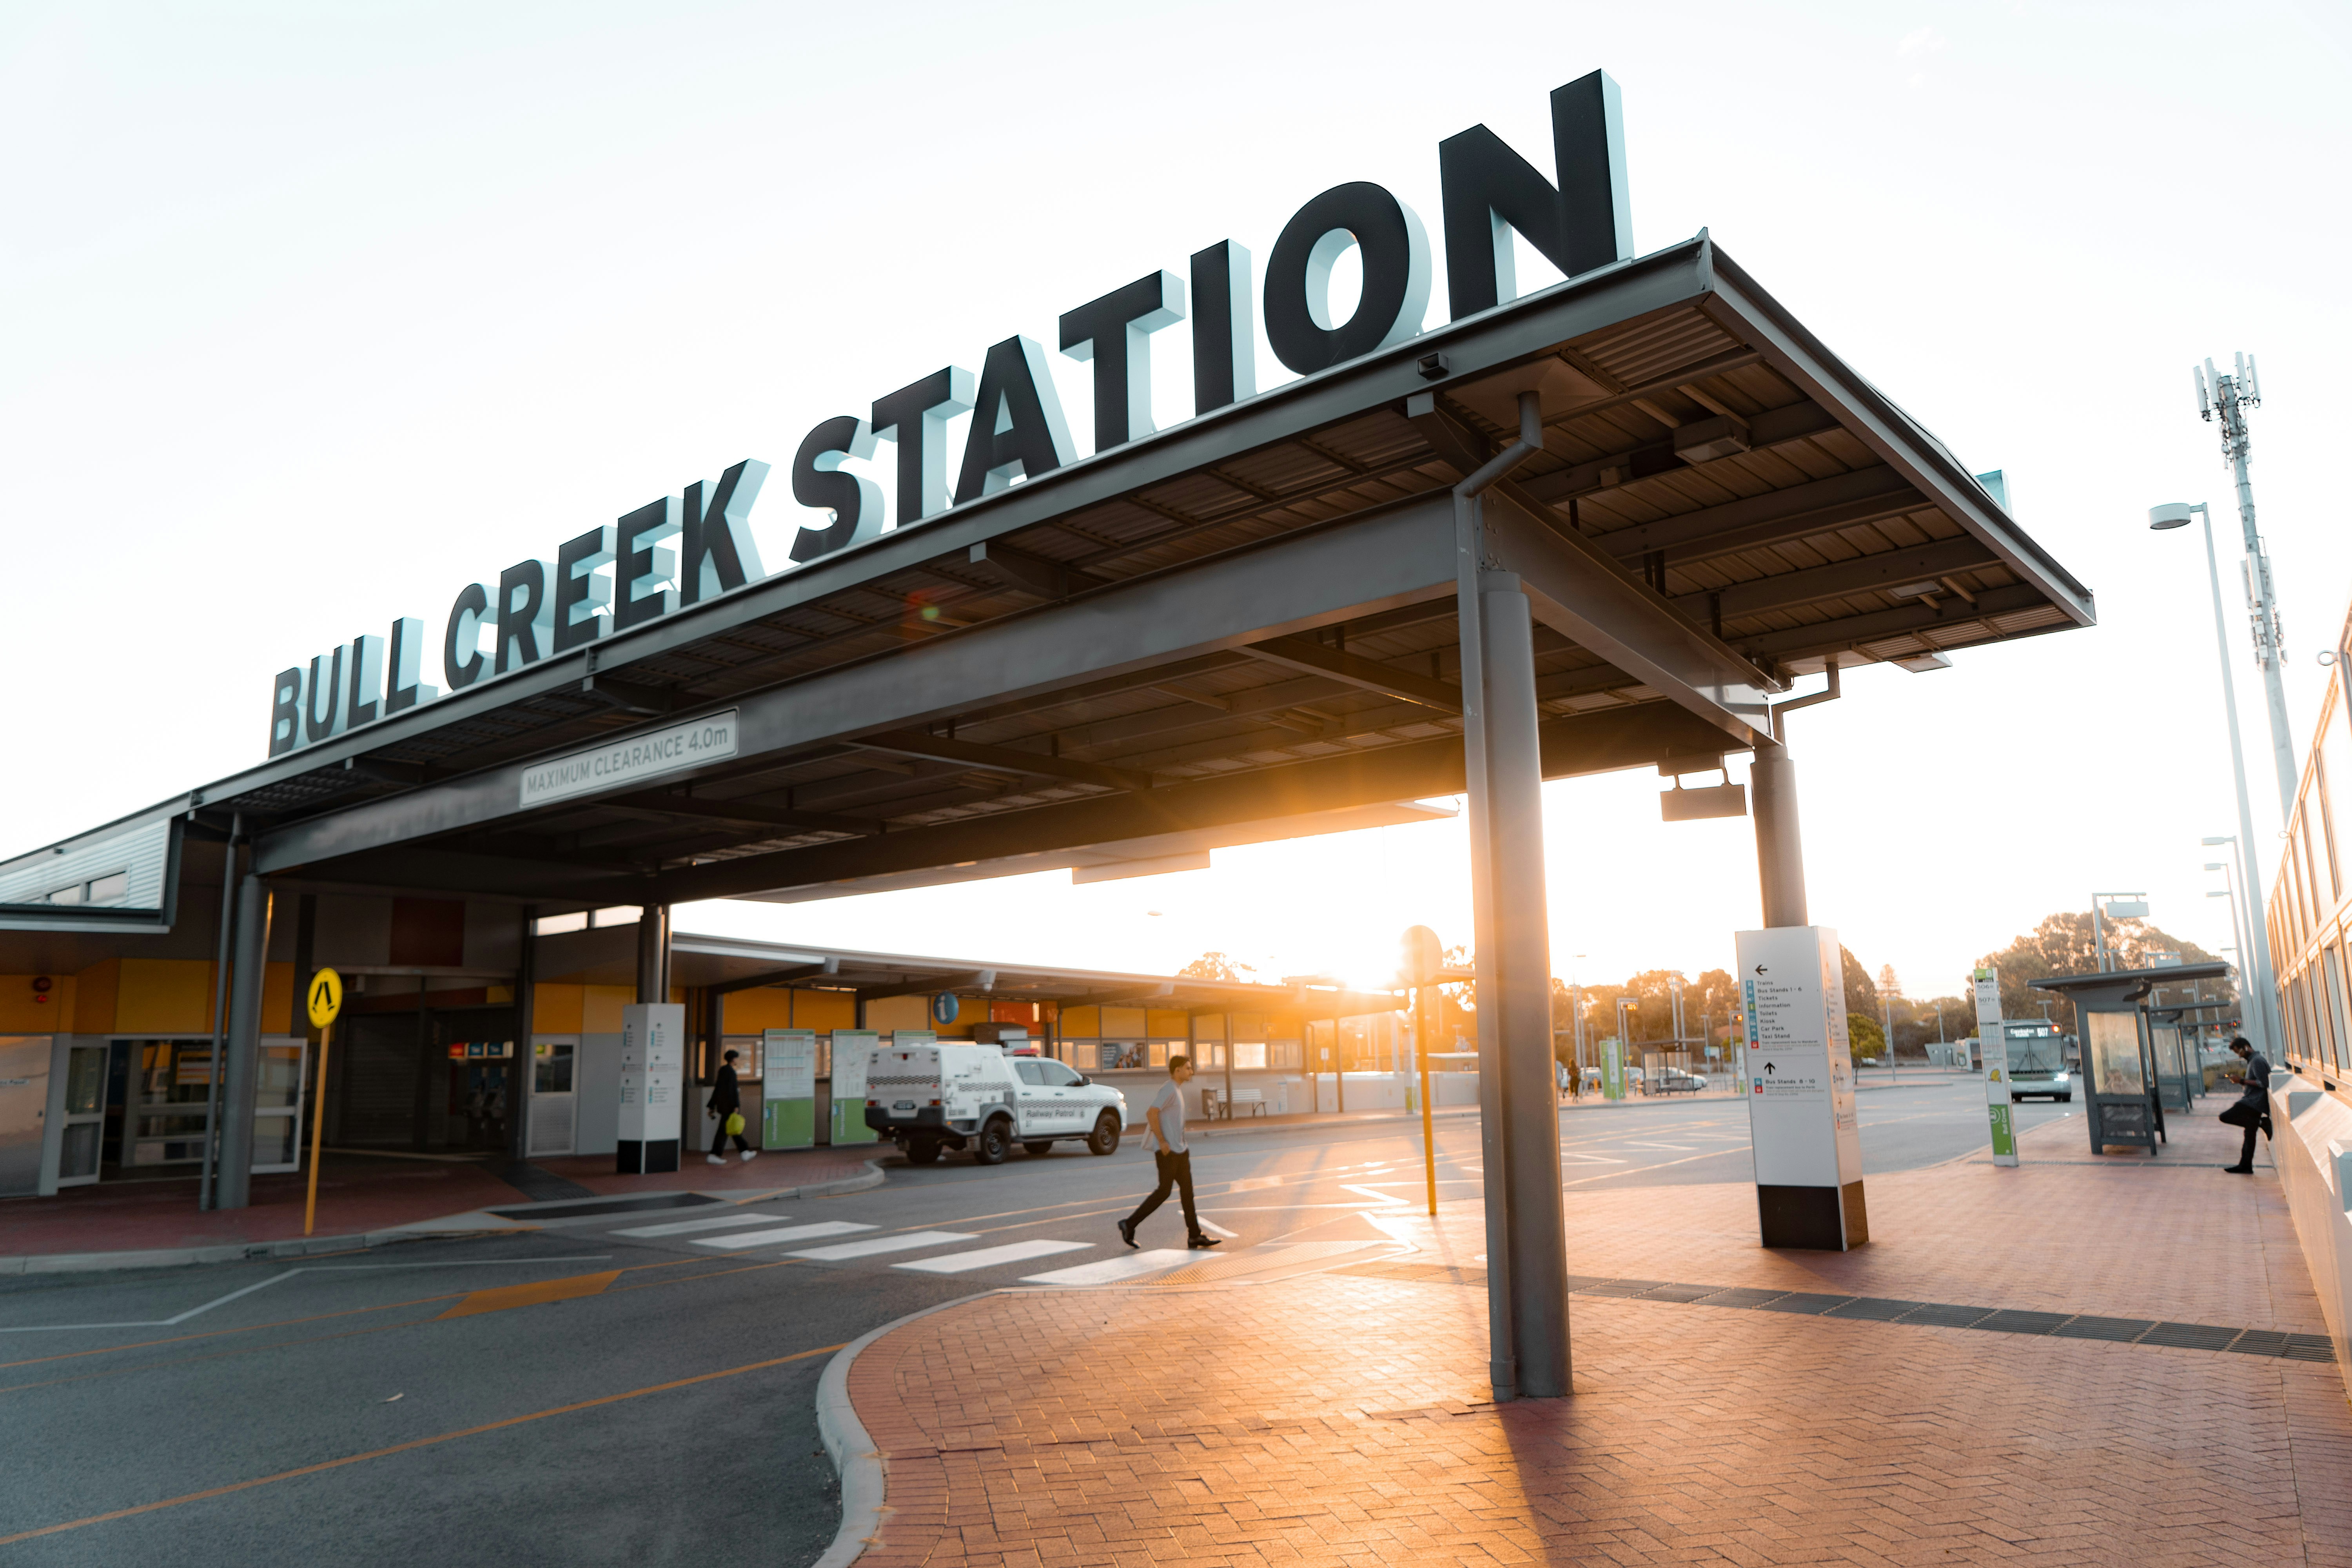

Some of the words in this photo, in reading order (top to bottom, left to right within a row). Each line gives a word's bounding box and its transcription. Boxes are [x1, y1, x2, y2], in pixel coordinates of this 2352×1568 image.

[269, 616, 436, 759] BULL
[445, 458, 771, 691] CREEK
[789, 68, 1631, 564] STATION
[527, 760, 590, 794] MAXIMUM
[595, 735, 683, 776] CLEARANCE
[688, 726, 728, 751] 4.0m
[2036, 1027, 2048, 1037] 507
